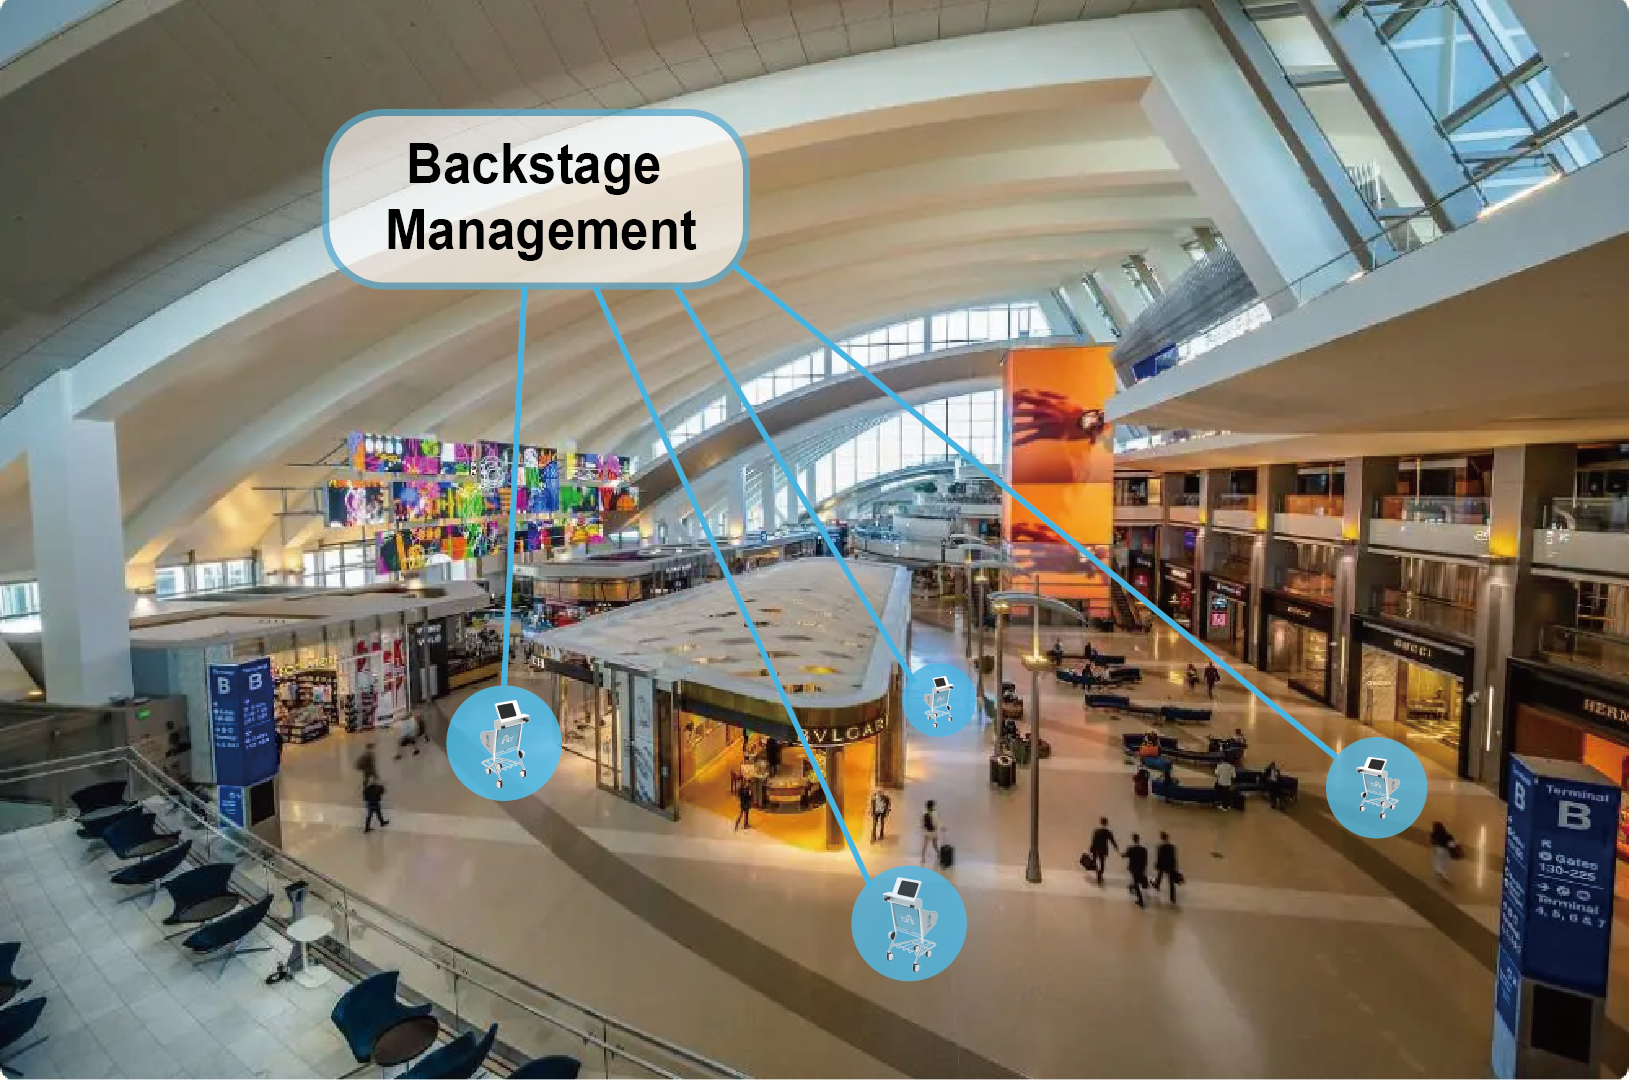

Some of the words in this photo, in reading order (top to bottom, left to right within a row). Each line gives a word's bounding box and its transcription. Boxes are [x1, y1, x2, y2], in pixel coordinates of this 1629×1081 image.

[217, 677, 231, 695] B
[248, 673, 263, 691] B
[1515, 780, 1526, 811] B
[1546, 784, 1609, 803] Terminal
[1558, 800, 1591, 830] B
[1556, 854, 1598, 871] Gates
[1536, 893, 1599, 915] Terminal
